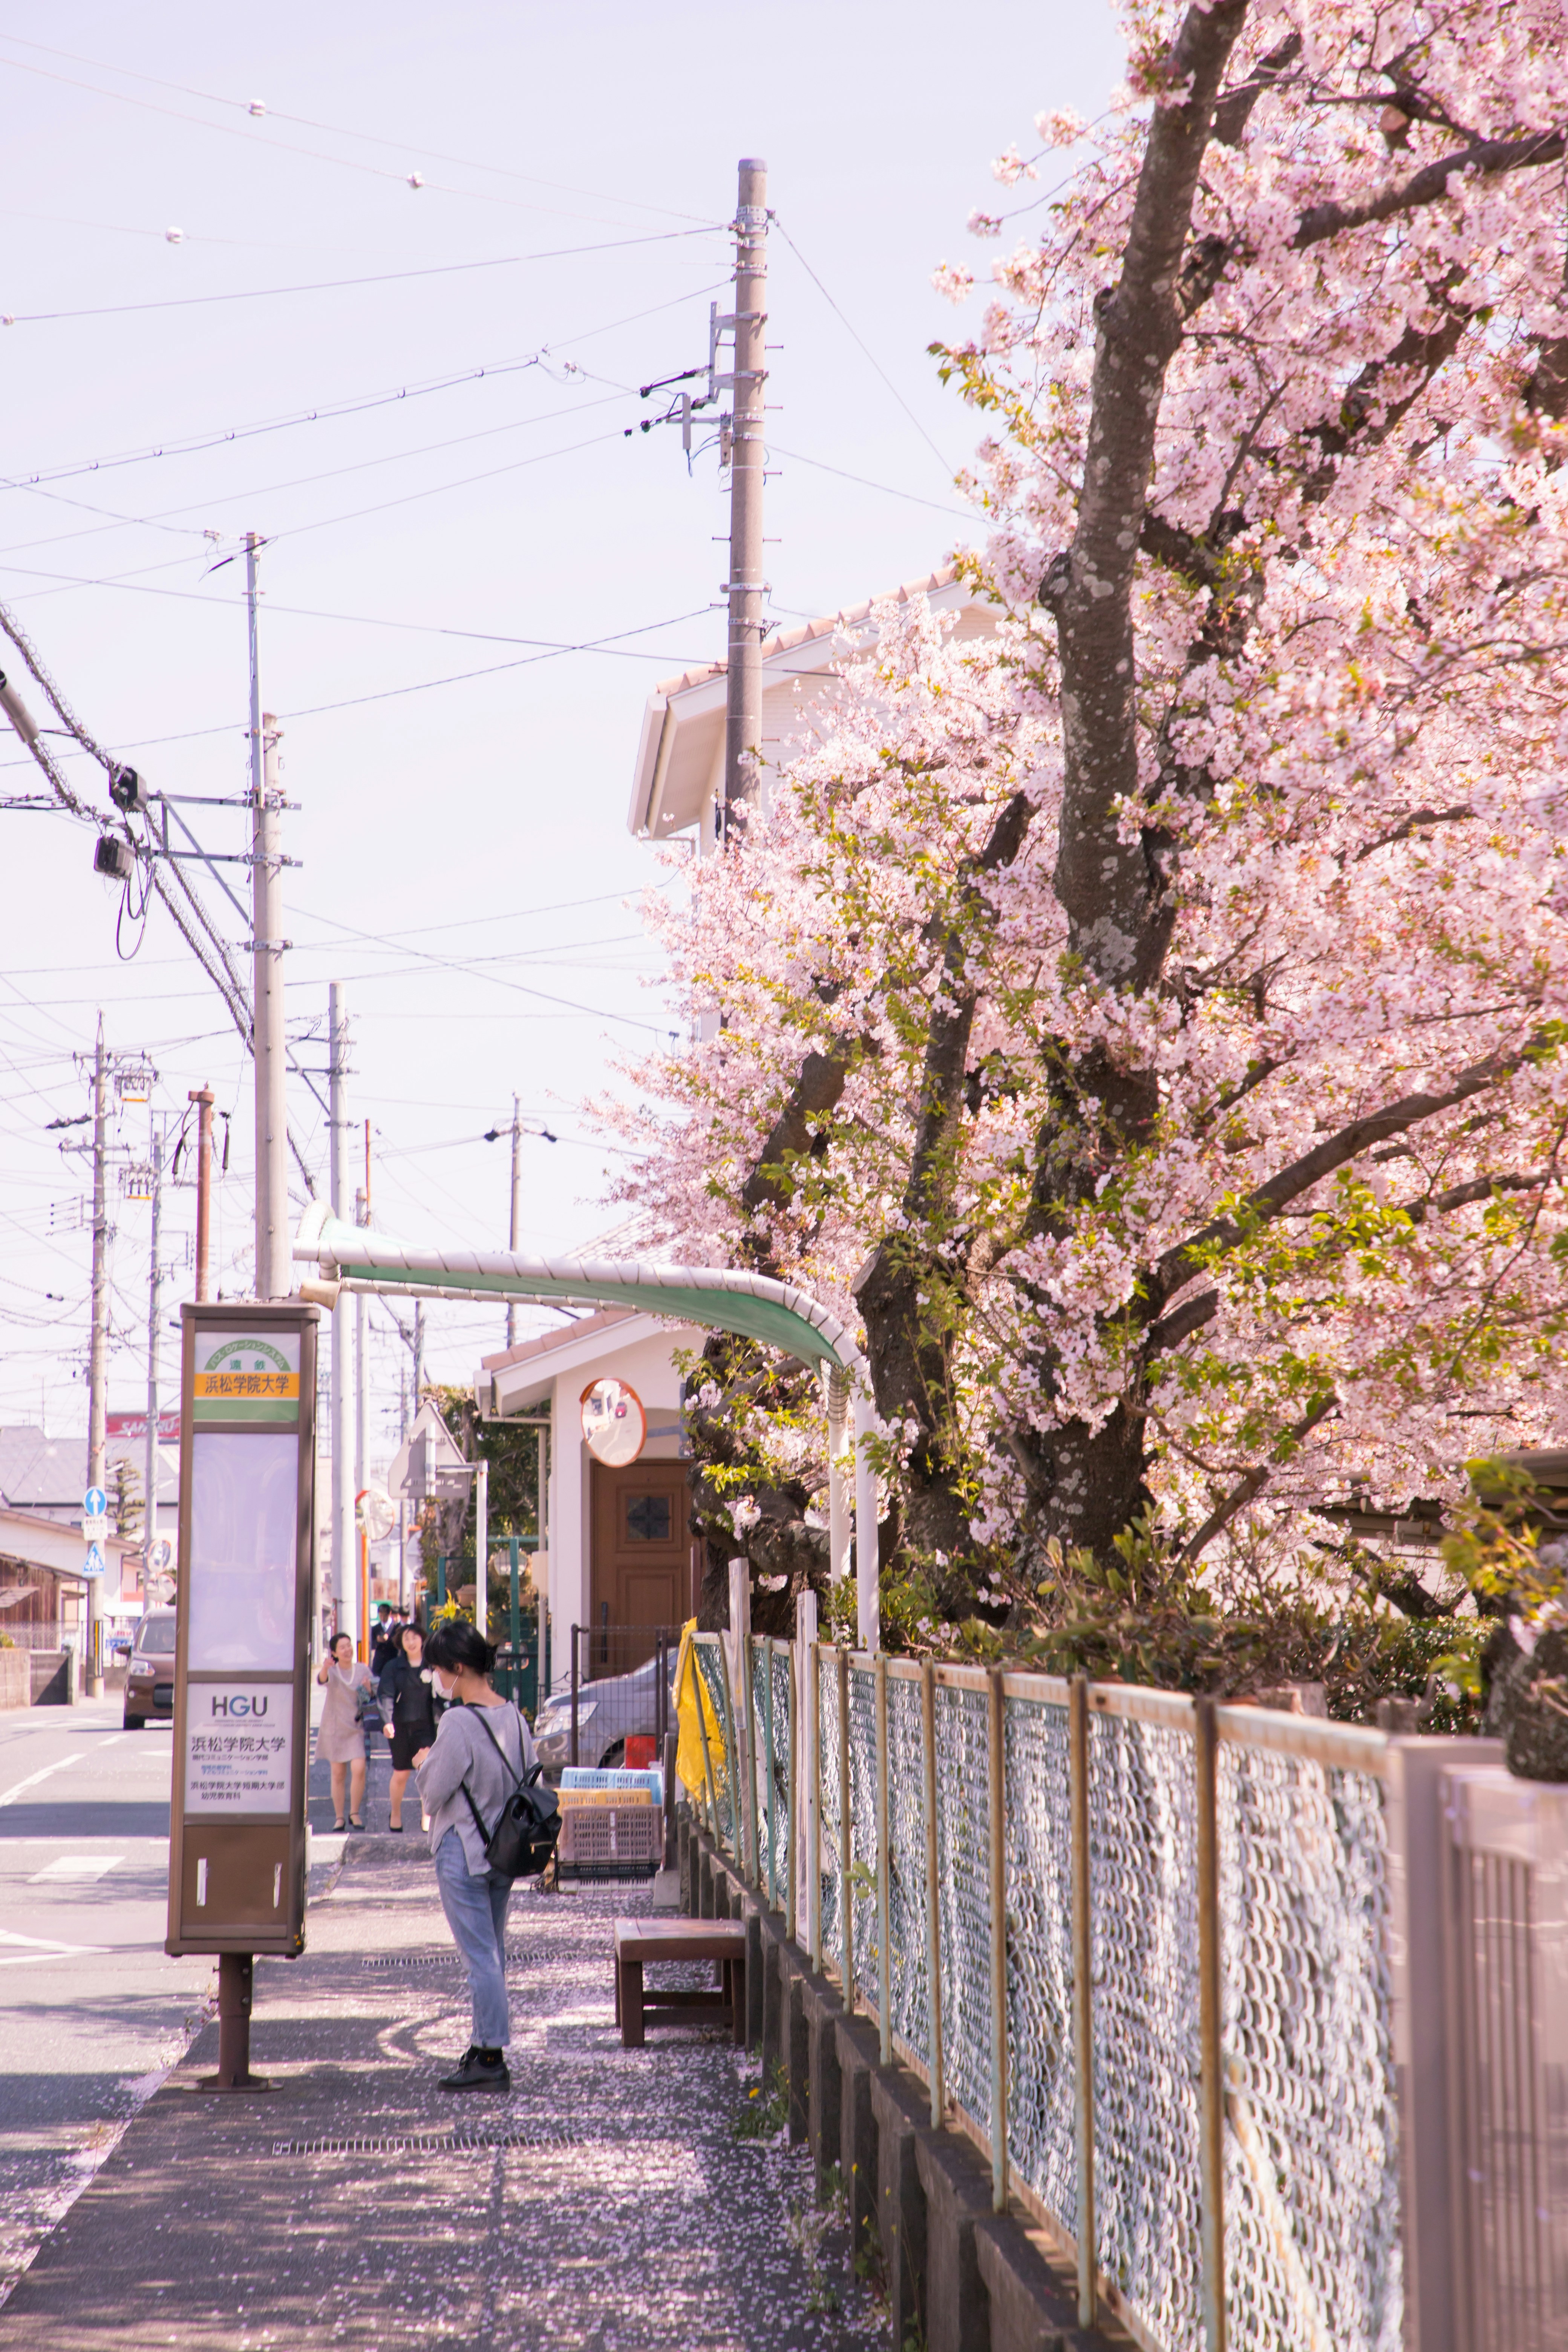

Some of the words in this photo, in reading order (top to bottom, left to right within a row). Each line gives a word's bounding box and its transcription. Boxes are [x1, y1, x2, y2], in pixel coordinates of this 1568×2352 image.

[205, 1375, 289, 1394] 浜松学院大学
[212, 1695, 268, 1717] HGU
[191, 1736, 285, 1752] 浜松学院大学
[191, 1781, 285, 1790] 浜松学院大学短期大学部
